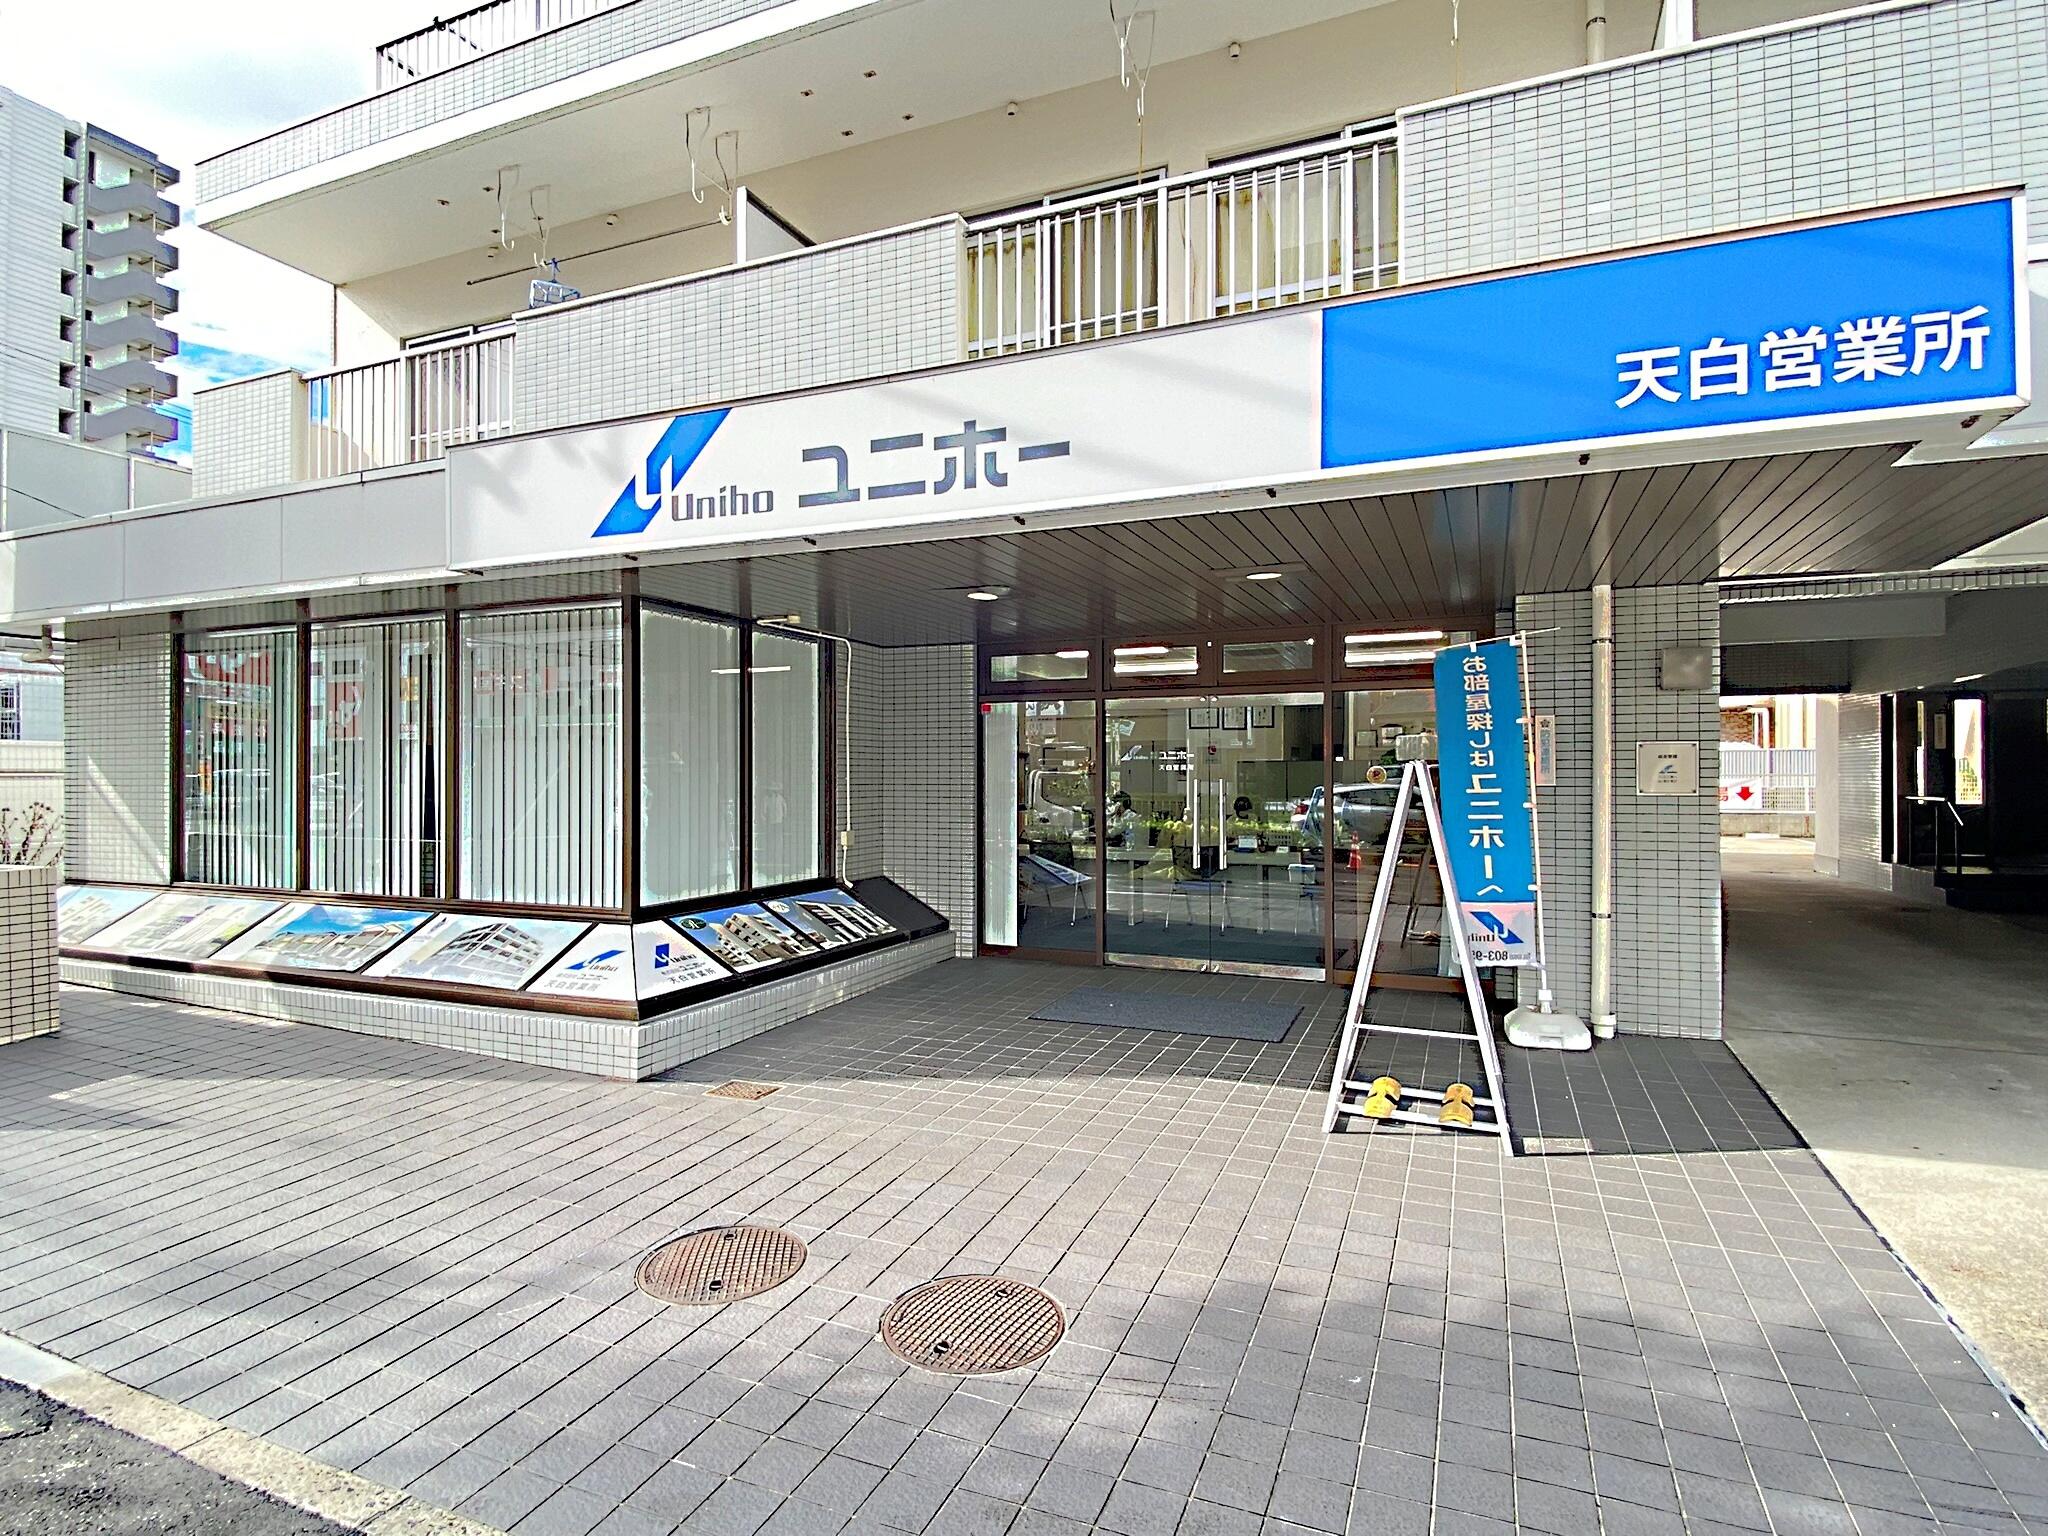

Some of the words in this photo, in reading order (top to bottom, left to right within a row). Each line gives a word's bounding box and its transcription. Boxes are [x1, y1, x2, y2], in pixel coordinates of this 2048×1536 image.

[1614, 305, 1991, 409] 天白営業所
[671, 485, 774, 522] Uniho
[798, 419, 1071, 508] ユニホー
